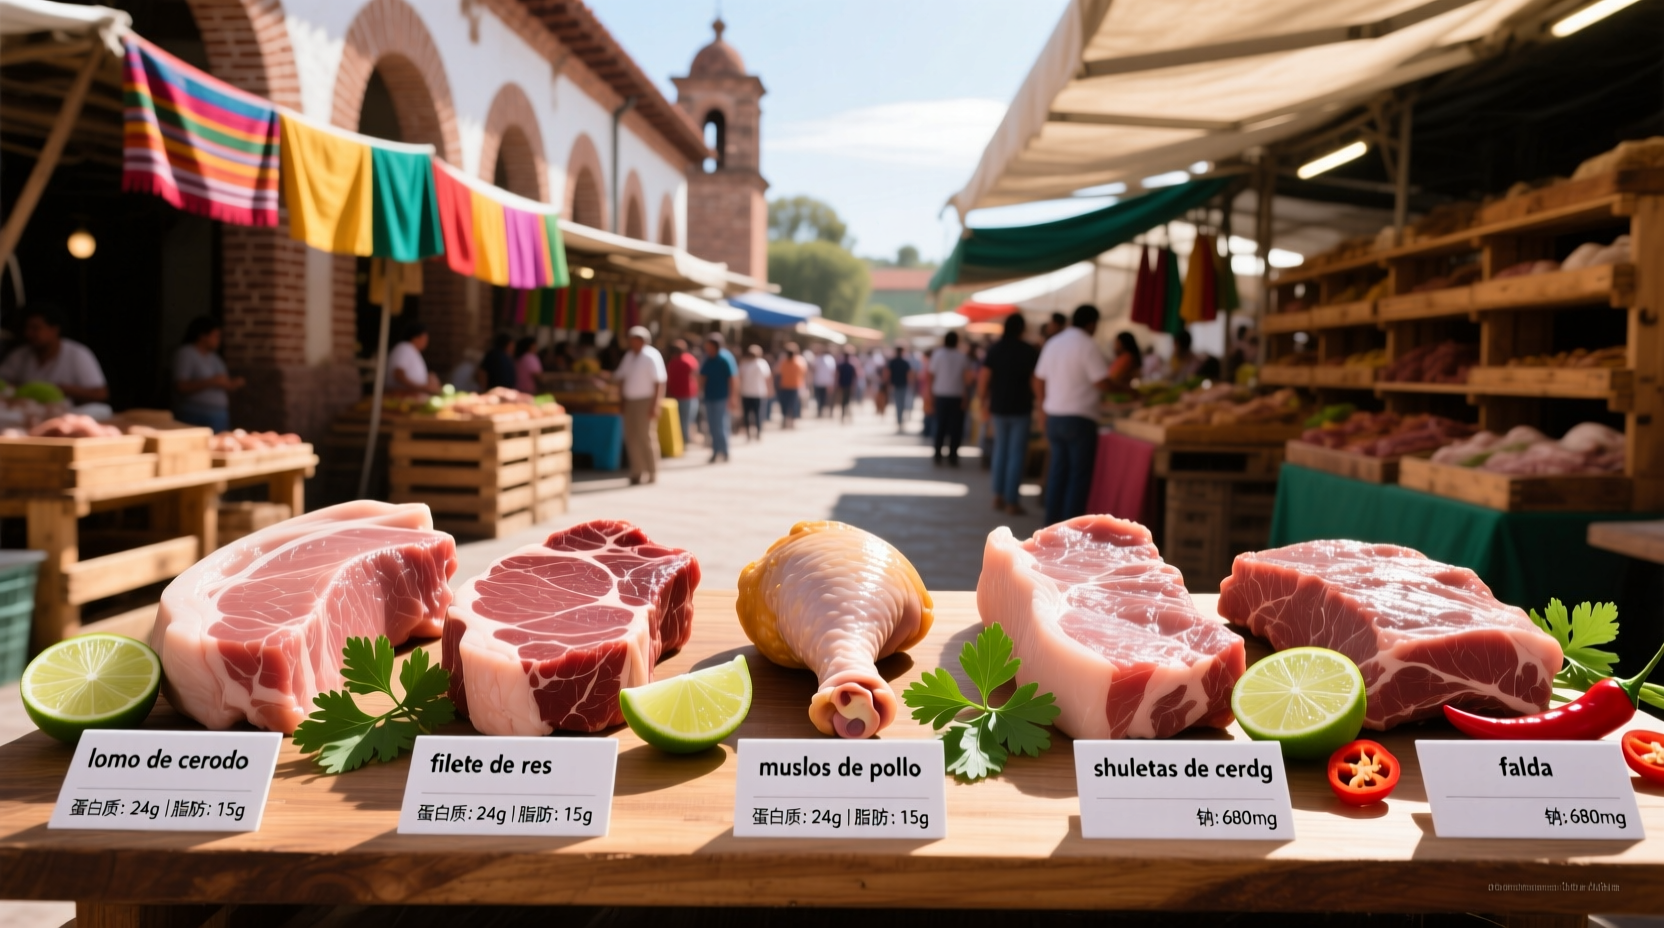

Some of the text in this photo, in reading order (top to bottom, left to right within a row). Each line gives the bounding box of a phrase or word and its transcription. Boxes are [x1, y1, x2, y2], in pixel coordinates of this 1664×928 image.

[87, 747, 249, 770] lomo de cerodo
[429, 752, 553, 775] filete de res
[759, 755, 922, 783] muslos de pollo
[1498, 755, 1554, 777] falda
[1093, 756, 1273, 785] shuletas de cerdg
[129, 799, 160, 820] 24g
[217, 801, 246, 822] 15g
[476, 805, 507, 826] 24g
[564, 806, 593, 827] 15g
[811, 808, 842, 829] 24g
[900, 809, 929, 830] 15g
